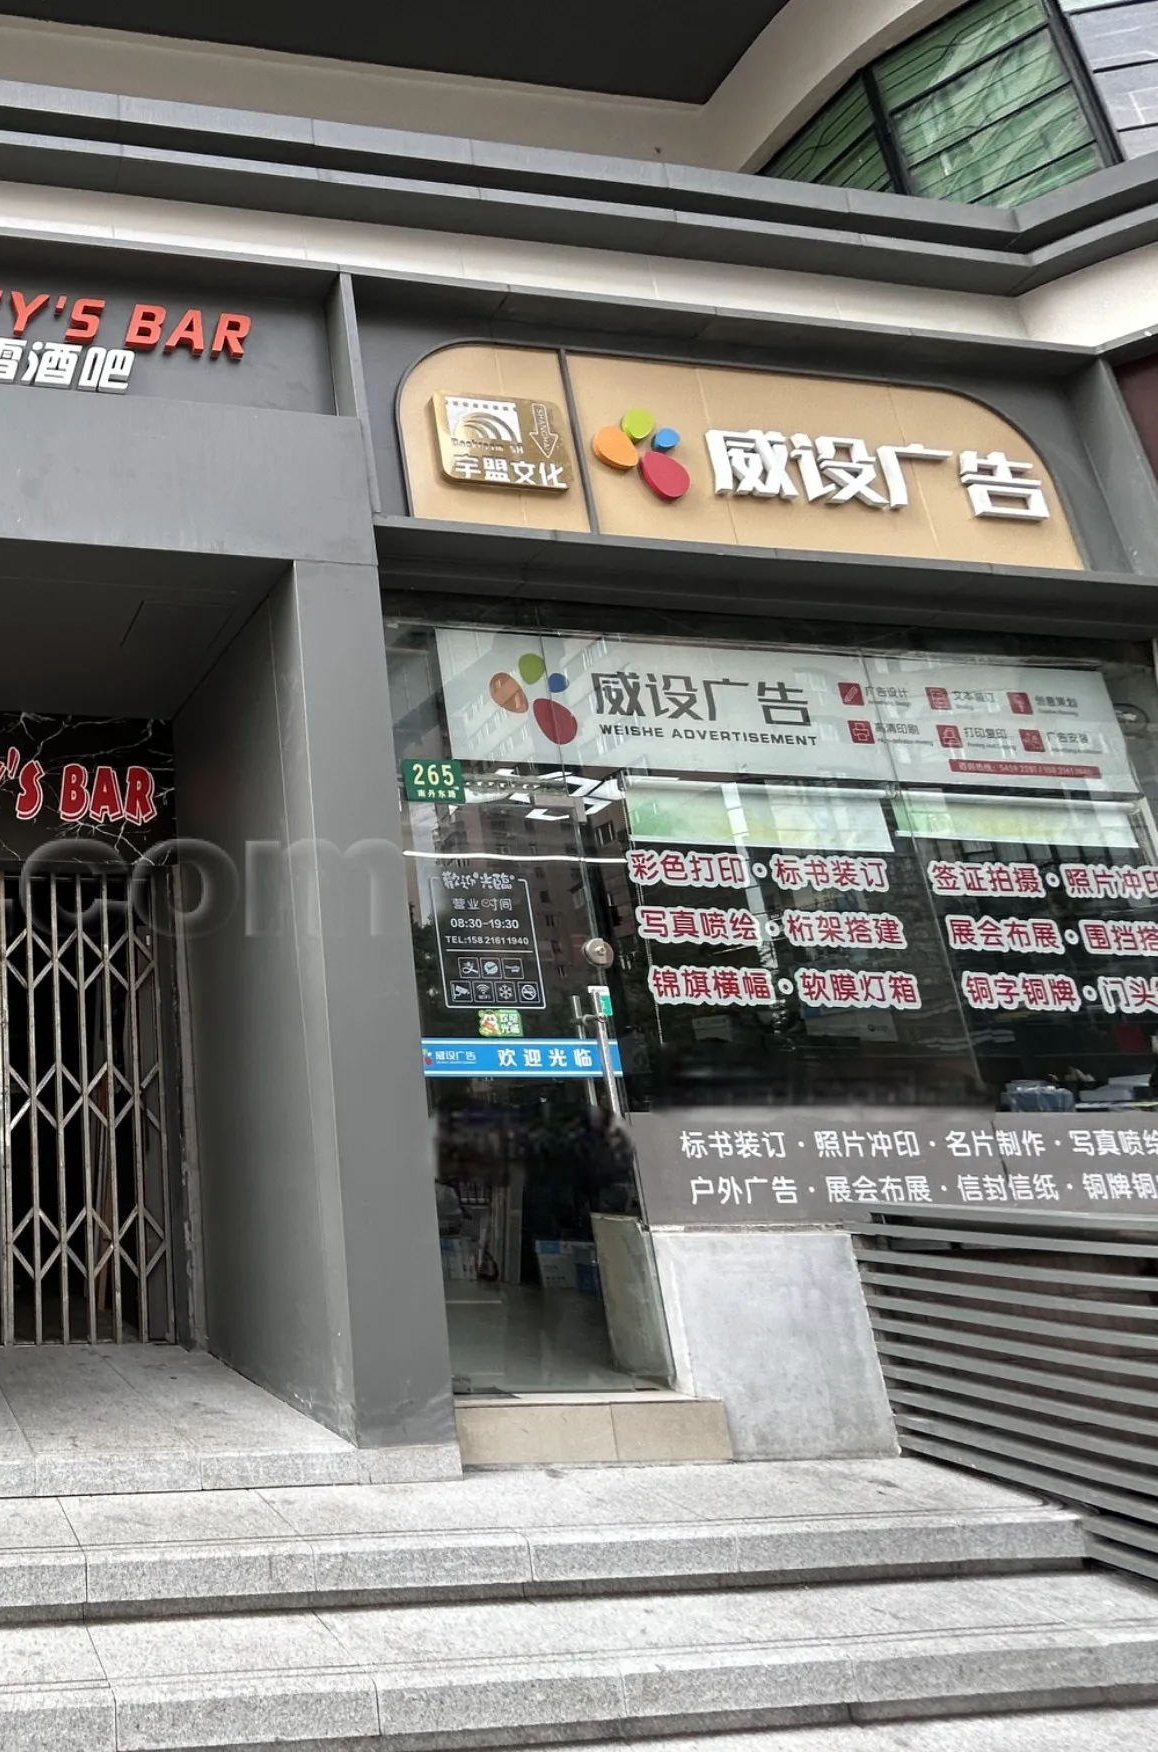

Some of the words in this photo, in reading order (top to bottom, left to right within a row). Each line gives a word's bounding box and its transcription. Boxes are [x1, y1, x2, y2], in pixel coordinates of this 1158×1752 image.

[125, 303, 252, 360] BAR
[705, 429, 1049, 523] 威设广告
[591, 671, 812, 727] 威设广告
[600, 723, 664, 738] WEISHE
[671, 728, 818, 746] ADVERTISEMENT
[412, 763, 455, 787] 265
[59, 763, 157, 826] BAR
[631, 853, 745, 885] 彩色打印
[774, 858, 887, 890] 标书装订
[932, 864, 1042, 893] 签证拍摄
[450, 918, 519, 929] 08:30-19:30
[641, 910, 759, 941] 写真喷绘
[787, 914, 904, 945] 桁架搭建
[949, 919, 1060, 949] 展会布展
[652, 969, 771, 1001] 锦旗横幅
[799, 972, 917, 1004] 软膜灯箱
[965, 976, 1076, 1005] 铜字铜牌
[497, 1048, 593, 1068] 欢迎光临
[680, 1131, 785, 1159] 标书装订
[814, 1131, 920, 1158] 照片冲印
[946, 1129, 1046, 1157] 名片制作
[690, 1176, 797, 1204] 户外广告
[827, 1175, 934, 1203] 展会布展
[957, 1173, 1060, 1202] 信封信纸
